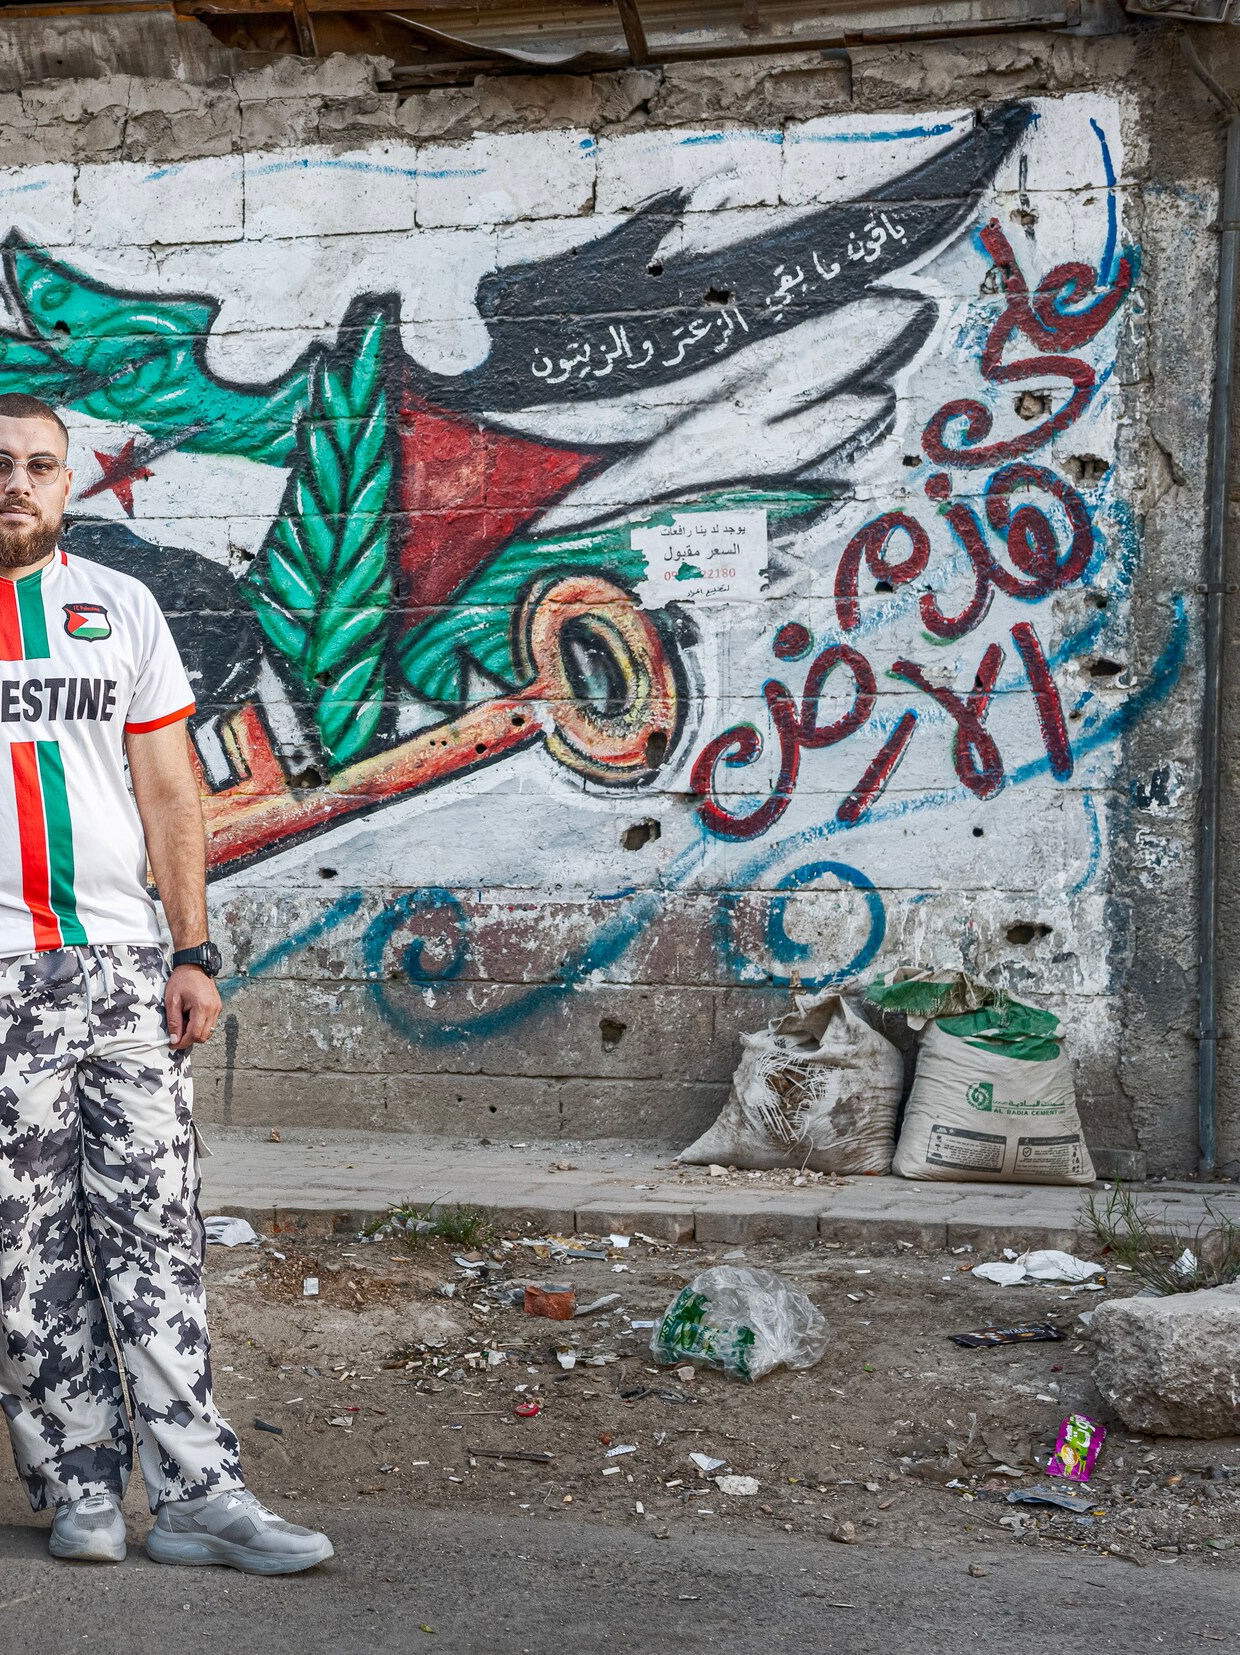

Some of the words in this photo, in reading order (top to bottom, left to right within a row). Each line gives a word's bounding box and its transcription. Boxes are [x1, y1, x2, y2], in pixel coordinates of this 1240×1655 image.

[847, 212, 909, 263] باقون
[812, 250, 842, 281] ما
[662, 307, 750, 368] الزعتر
[531, 324, 655, 385] والزيتون
[660, 524, 692, 538] رافعات
[722, 525, 746, 535] يوجد
[663, 544, 700, 561] مقبول
[706, 543, 740, 560] السعر
